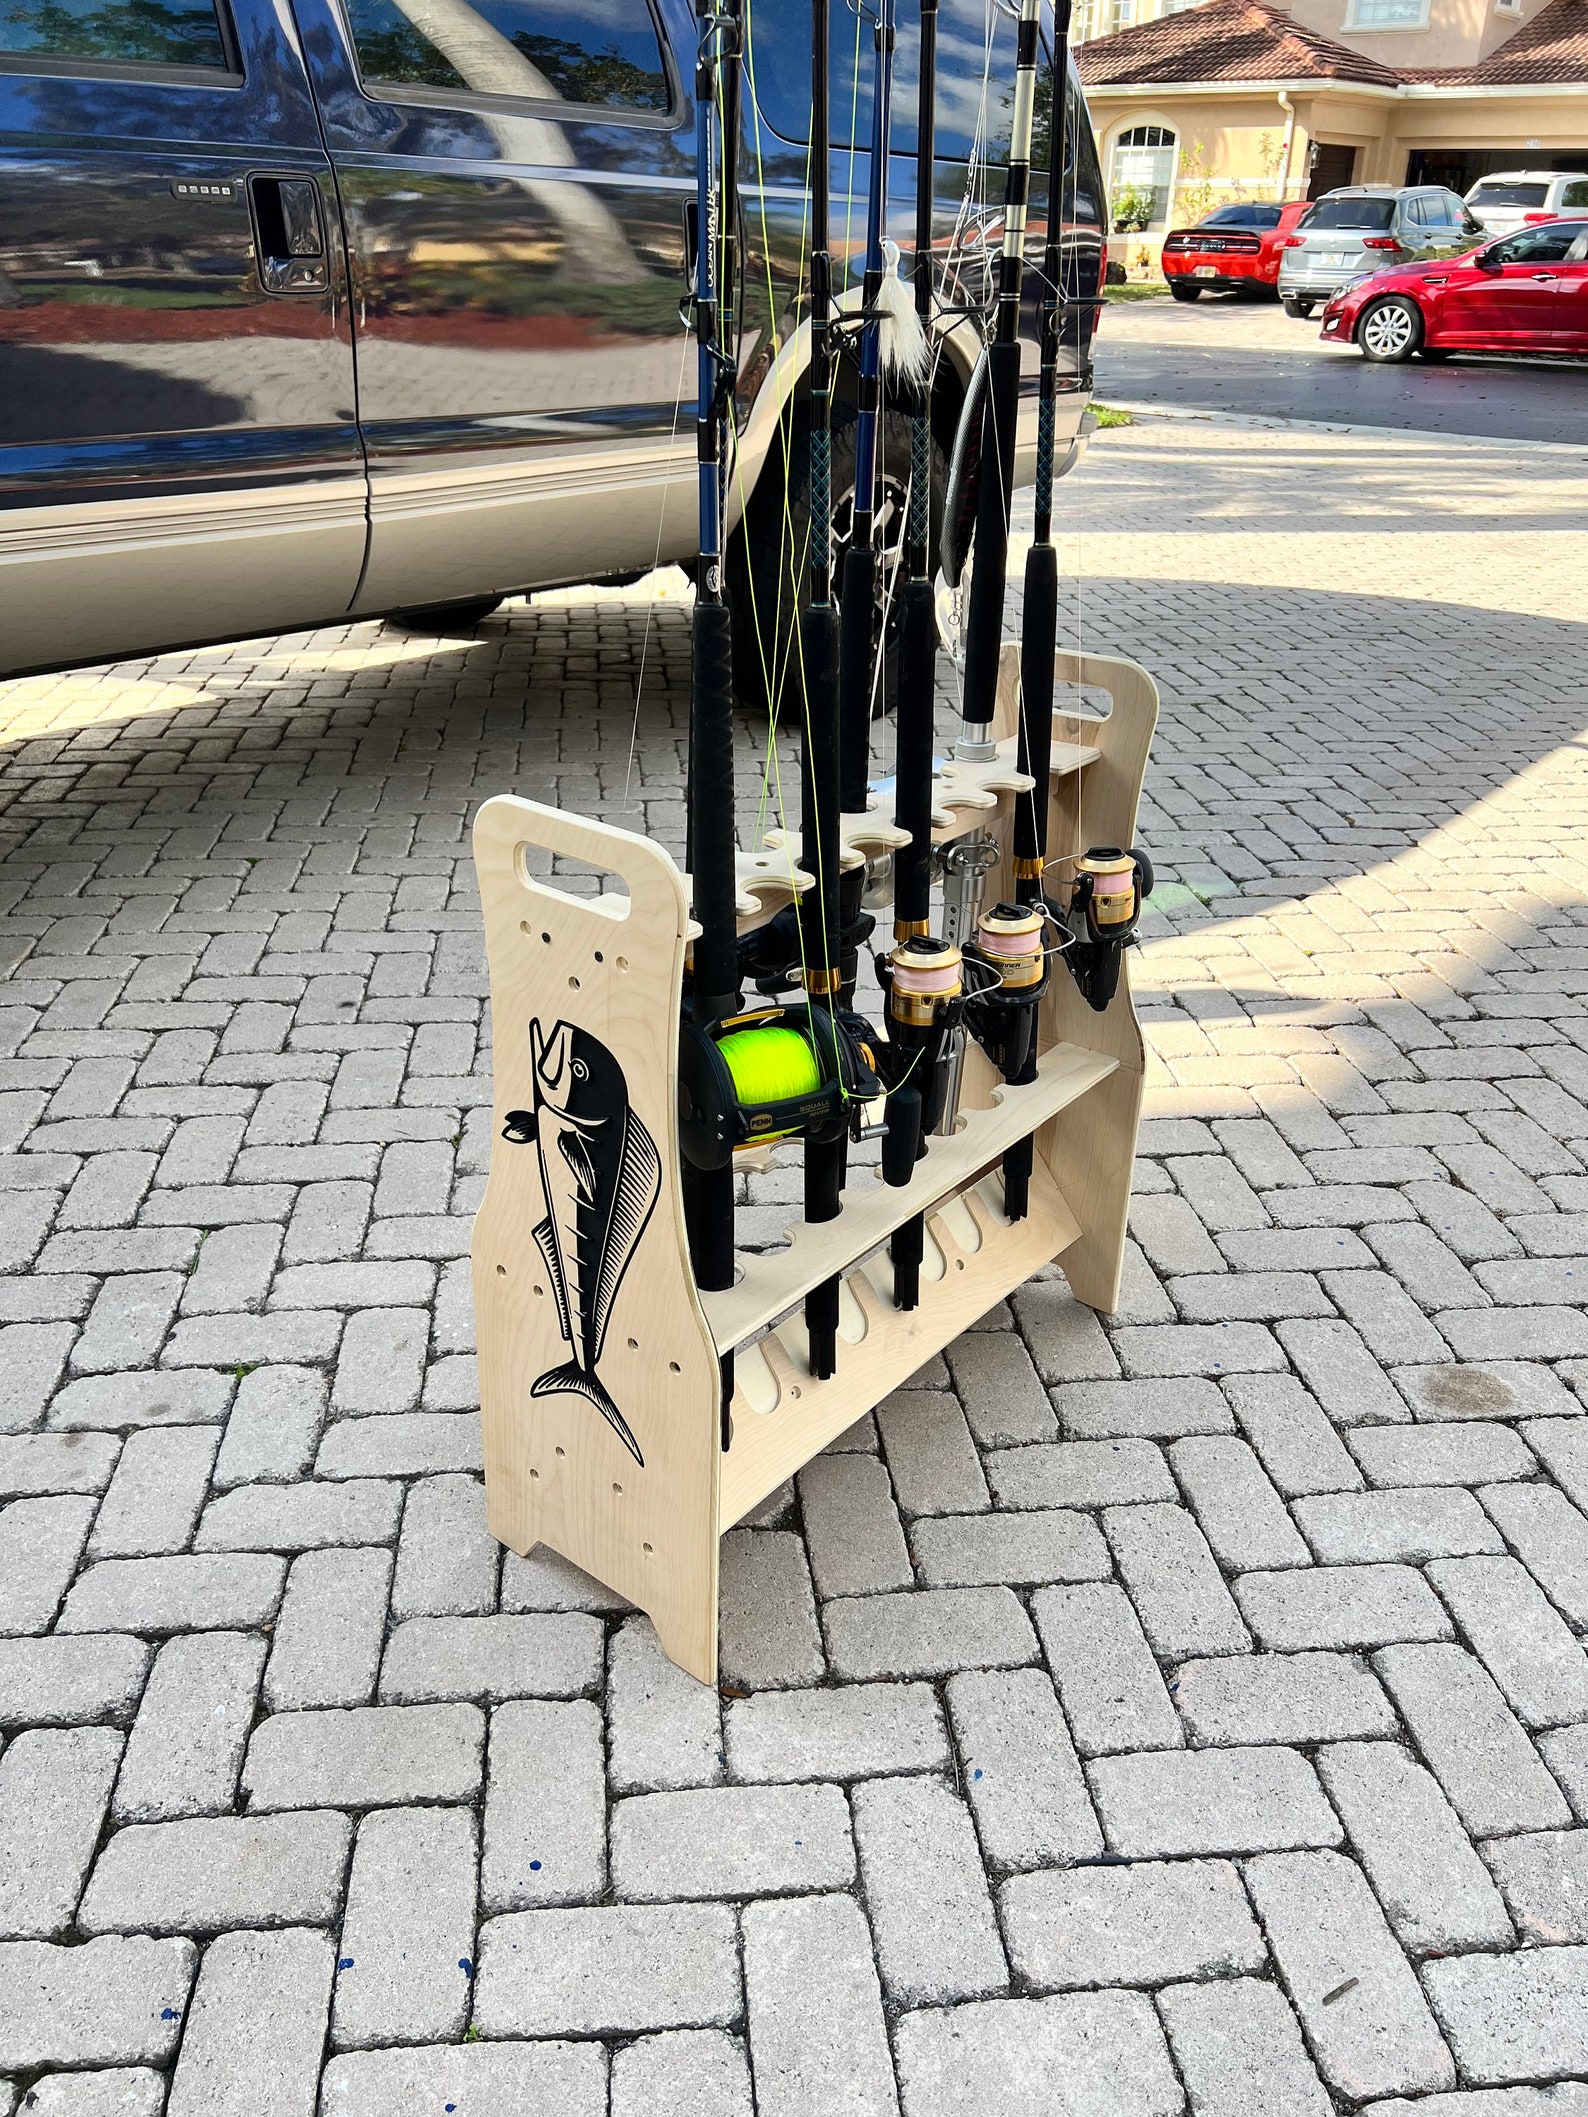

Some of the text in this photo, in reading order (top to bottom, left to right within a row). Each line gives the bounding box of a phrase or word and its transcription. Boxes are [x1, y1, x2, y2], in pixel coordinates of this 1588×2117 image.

[706, 188, 717, 242] MASTER
[800, 1100, 830, 1112] SQUALL
[751, 1117, 772, 1128] PENN
